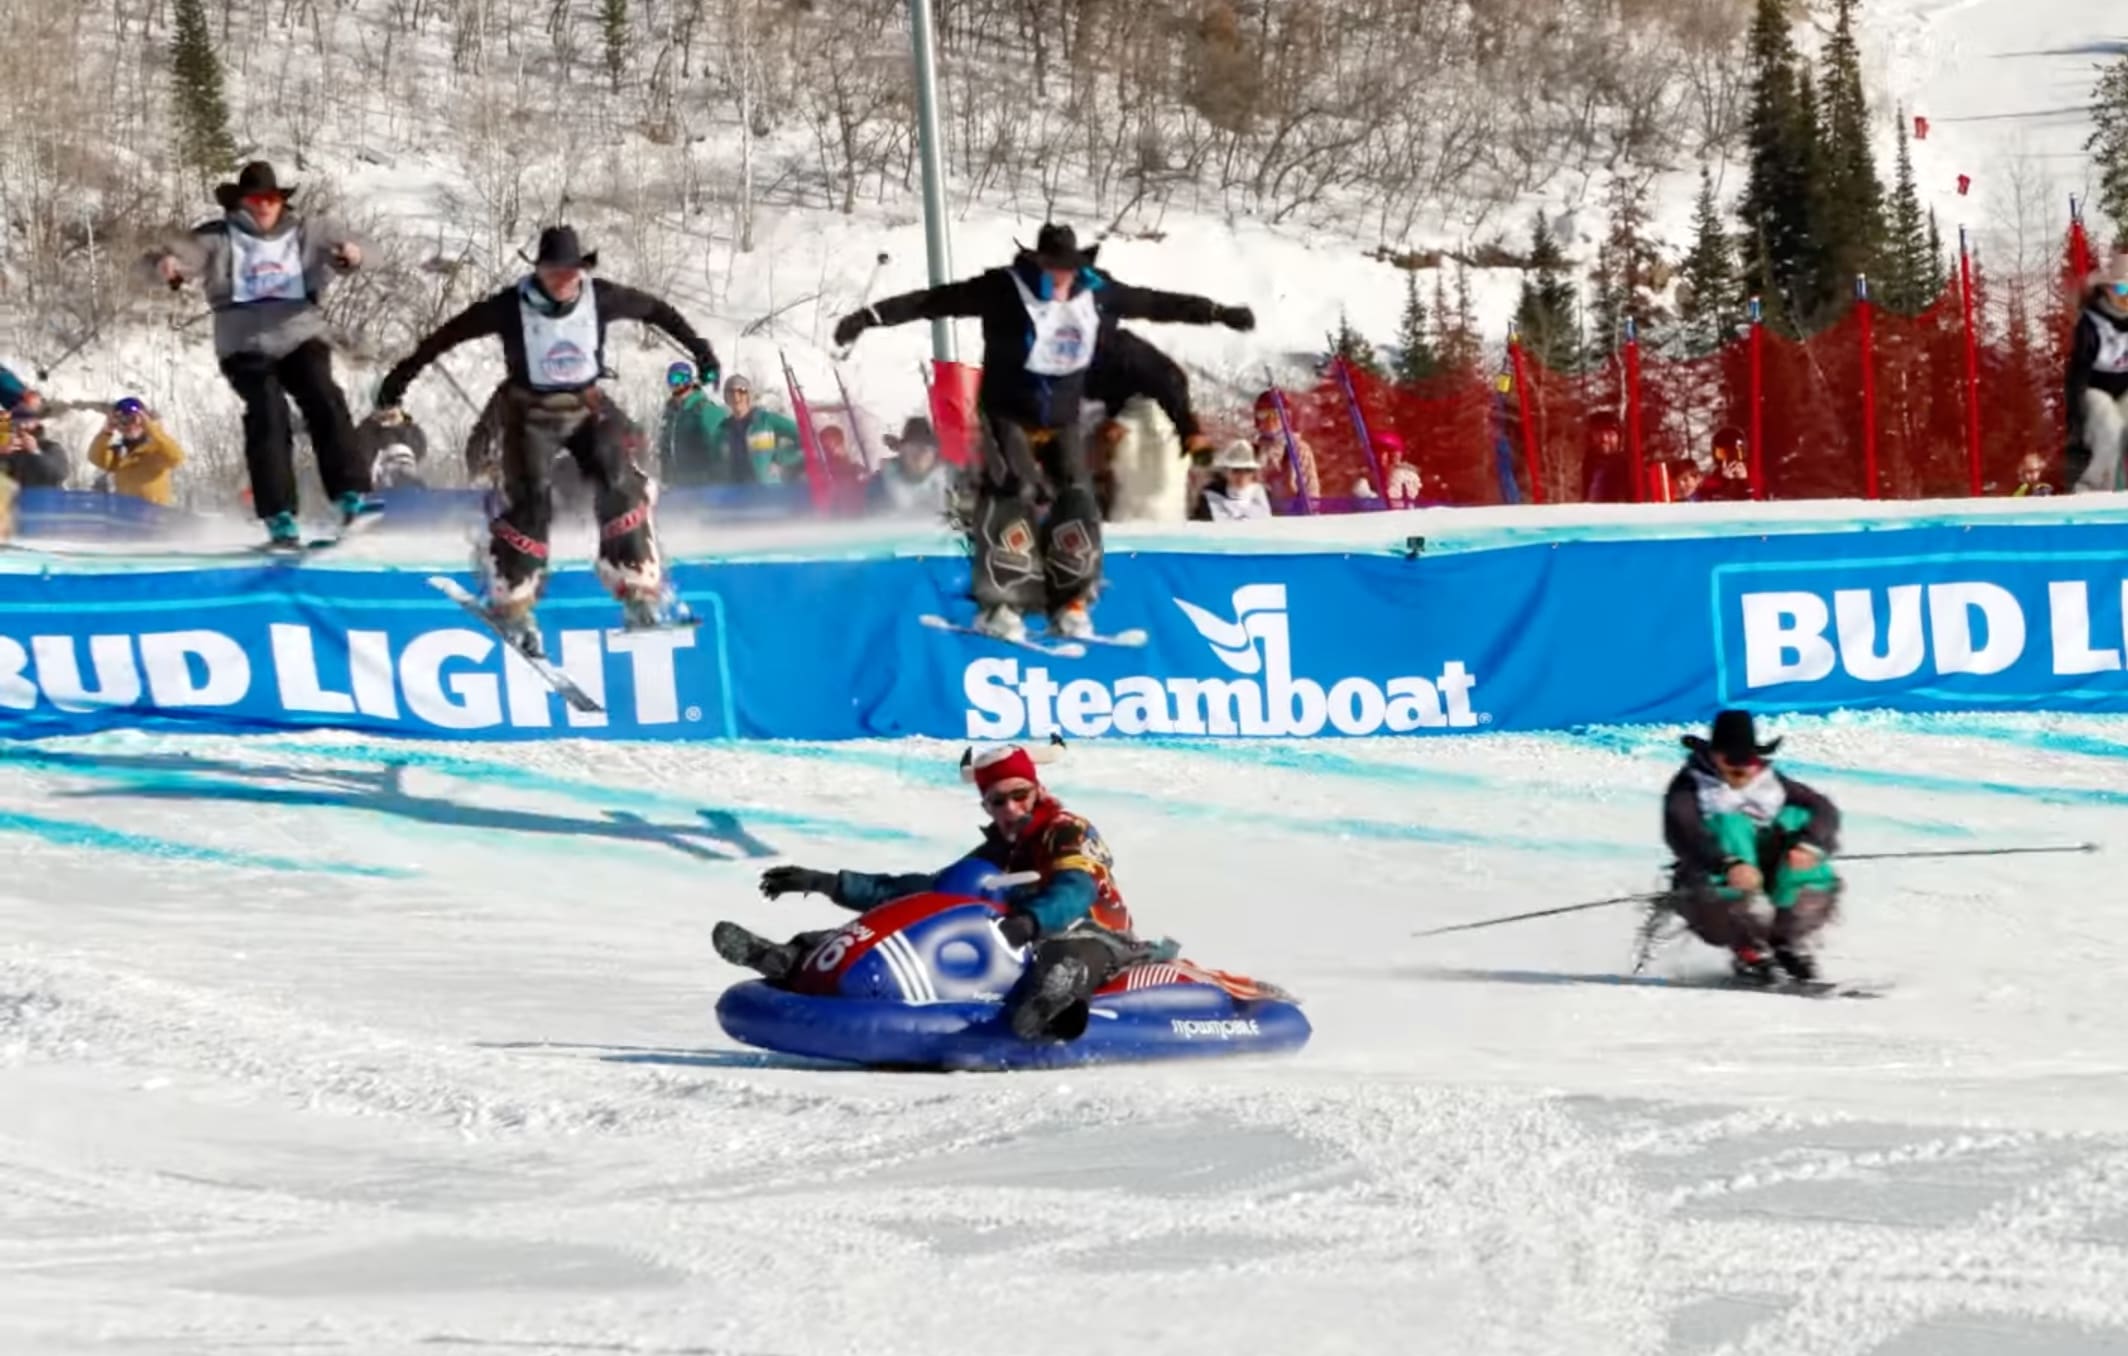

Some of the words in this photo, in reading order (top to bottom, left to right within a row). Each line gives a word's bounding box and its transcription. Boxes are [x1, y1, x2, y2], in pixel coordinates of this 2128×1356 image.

[269, 622, 696, 729] LIGHT
[963, 611, 1479, 739] Steamboat
[1741, 581, 2026, 689] BUD
[2048, 578, 2128, 675] L
